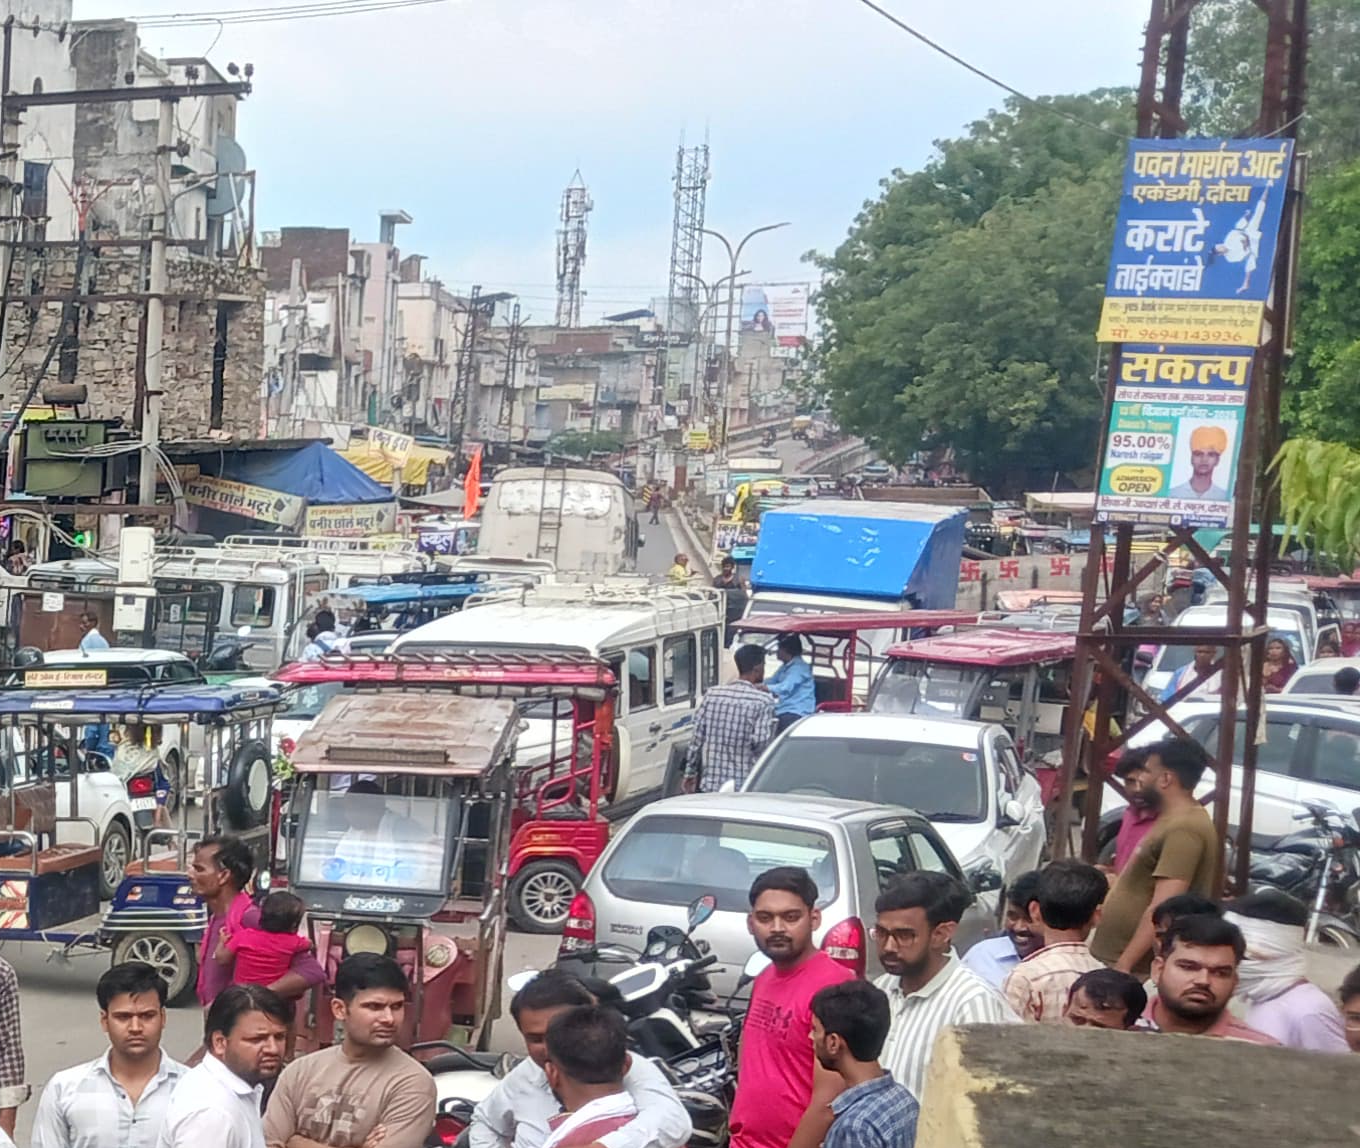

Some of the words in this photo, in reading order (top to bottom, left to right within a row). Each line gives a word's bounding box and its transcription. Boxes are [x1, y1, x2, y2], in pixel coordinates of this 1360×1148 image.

[1133, 150, 1178, 178] पवन
[1180, 141, 1242, 179] मार्शल
[1242, 142, 1287, 179] आर्ट
[1125, 207, 1211, 252] कराटे
[1114, 254, 1205, 296] ताईक्वांडो
[1138, 328, 1244, 343] 9694143936
[1121, 344, 1252, 386] संकल्प
[1112, 434, 1171, 450] 95.00%
[1116, 475, 1158, 483] ADMISSION
[1118, 482, 1152, 493] OPEN
[187, 483, 217, 501] पनीर
[218, 490, 246, 507] छोले
[309, 515, 332, 530] पनीर
